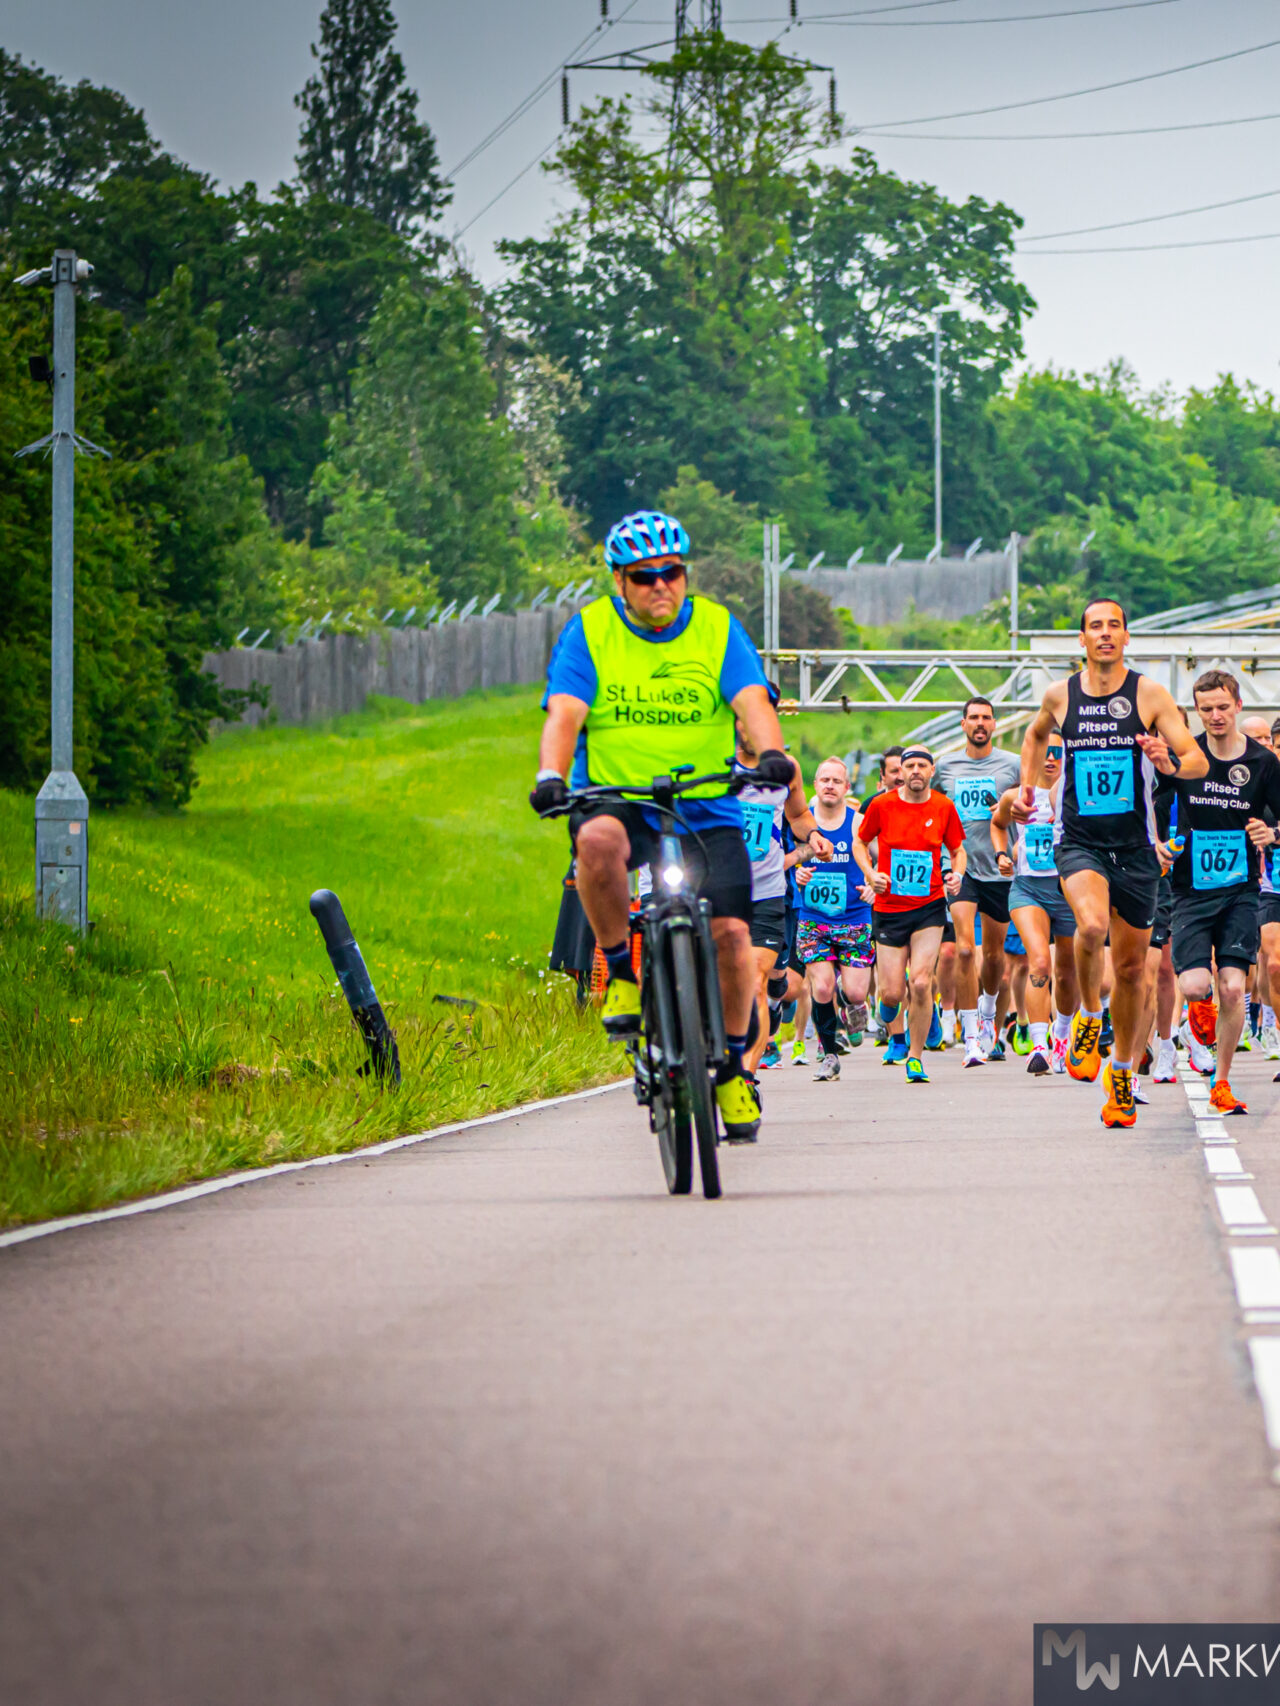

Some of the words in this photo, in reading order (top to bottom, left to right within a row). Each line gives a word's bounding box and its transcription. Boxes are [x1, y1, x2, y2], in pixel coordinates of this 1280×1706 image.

[606, 685, 632, 702] St.
[636, 685, 699, 705] Luke's
[615, 705, 702, 724] Hospice
[1079, 705, 1107, 716] MIKE
[1078, 721, 1118, 733] Pitsea
[1067, 736, 1107, 749] Running
[1109, 735, 1135, 745] Club
[1086, 770, 1125, 797] 187
[1203, 782, 1240, 795] Pitsea
[961, 790, 990, 808] 098
[1189, 795, 1228, 809] Running
[1229, 799, 1251, 810] Club
[743, 820, 763, 845] 61
[1034, 839, 1053, 857] 19
[1201, 848, 1240, 873] 067
[896, 864, 926, 883] 012
[810, 885, 840, 904] 095
